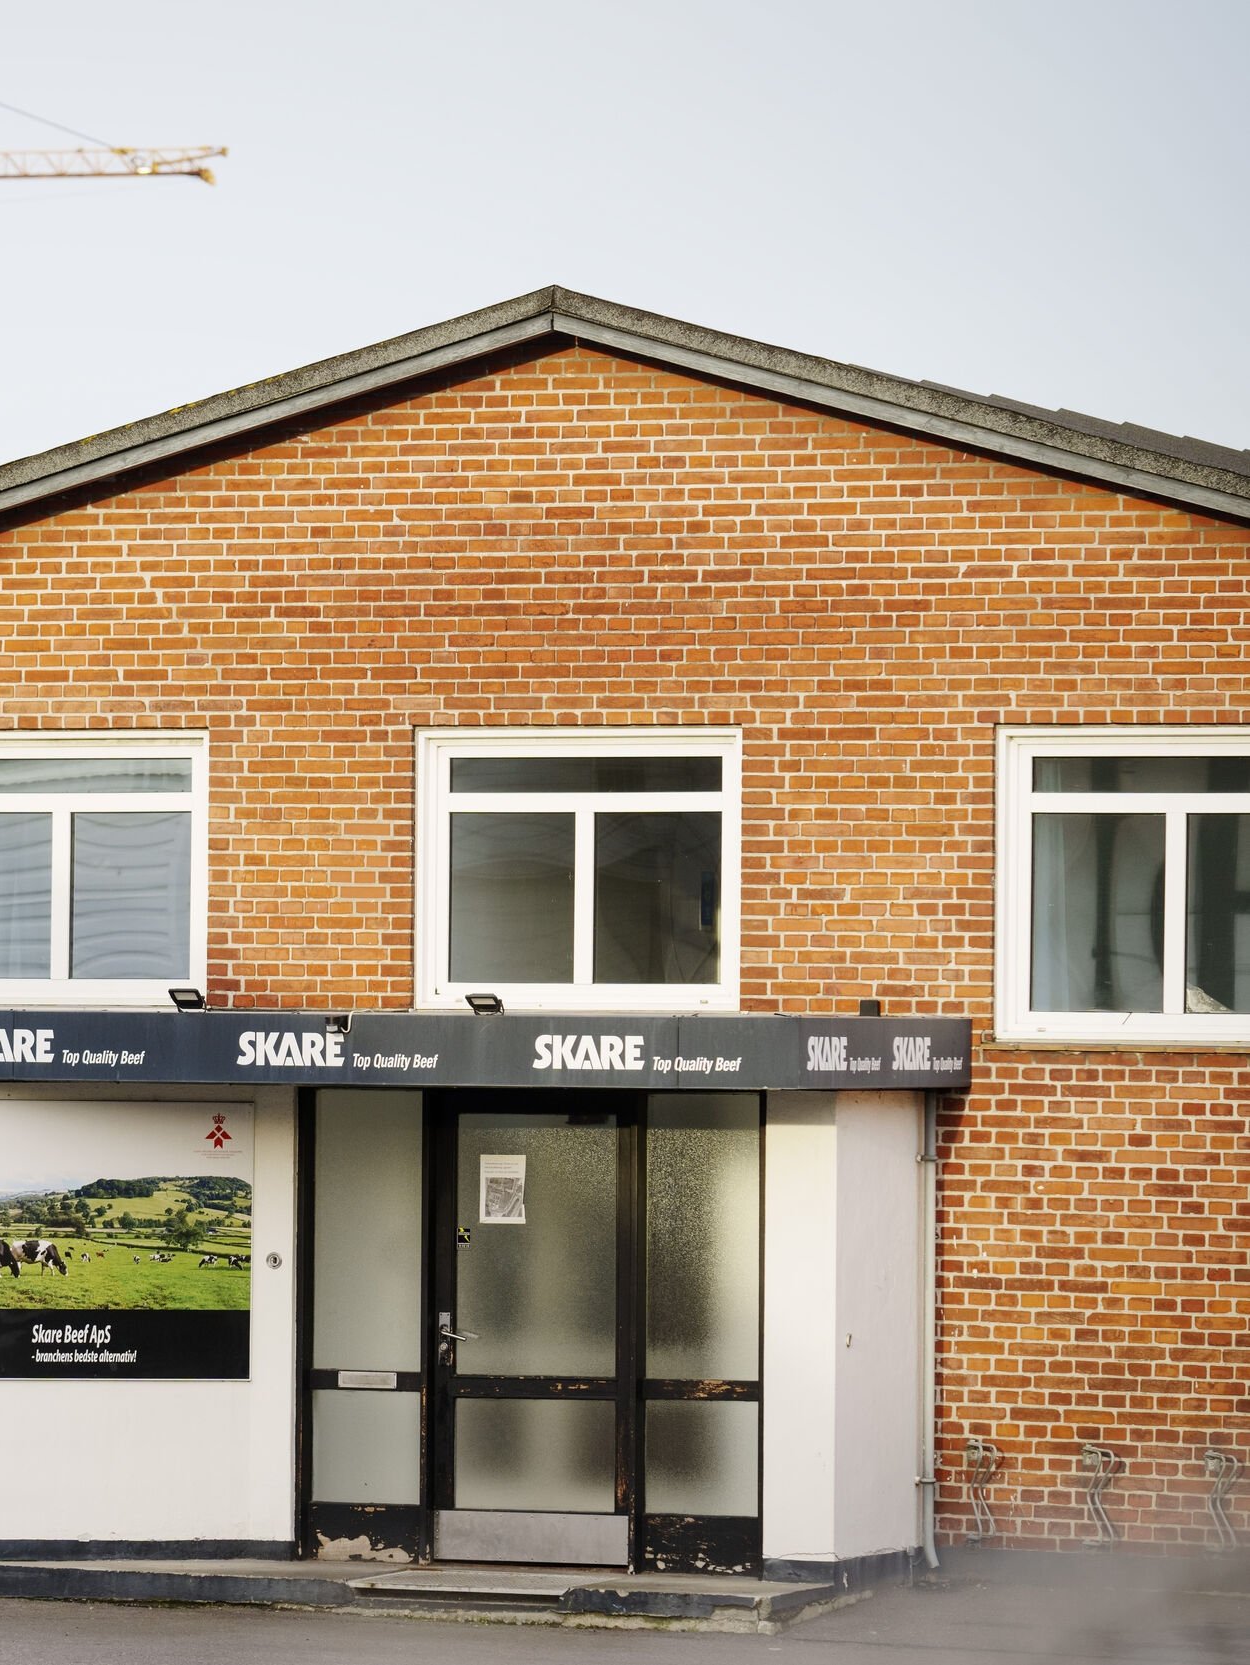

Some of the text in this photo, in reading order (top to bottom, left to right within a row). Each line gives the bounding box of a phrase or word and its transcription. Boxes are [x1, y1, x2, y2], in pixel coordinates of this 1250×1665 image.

[62, 1049, 80, 1066] Top
[82, 1050, 119, 1067] Quality
[120, 1050, 146, 1065] Beef
[236, 1031, 439, 1071] SKARE Top Quality Beef
[532, 1034, 742, 1074] SKARE Top Quality Beef
[806, 1036, 848, 1071] SKARE
[892, 1036, 931, 1071] SKARE
[31, 1323, 112, 1348] Skare Beef ApS
[35, 1349, 73, 1362] branchens
[74, 1349, 98, 1362] bedste
[98, 1349, 137, 1362] alternativ!
